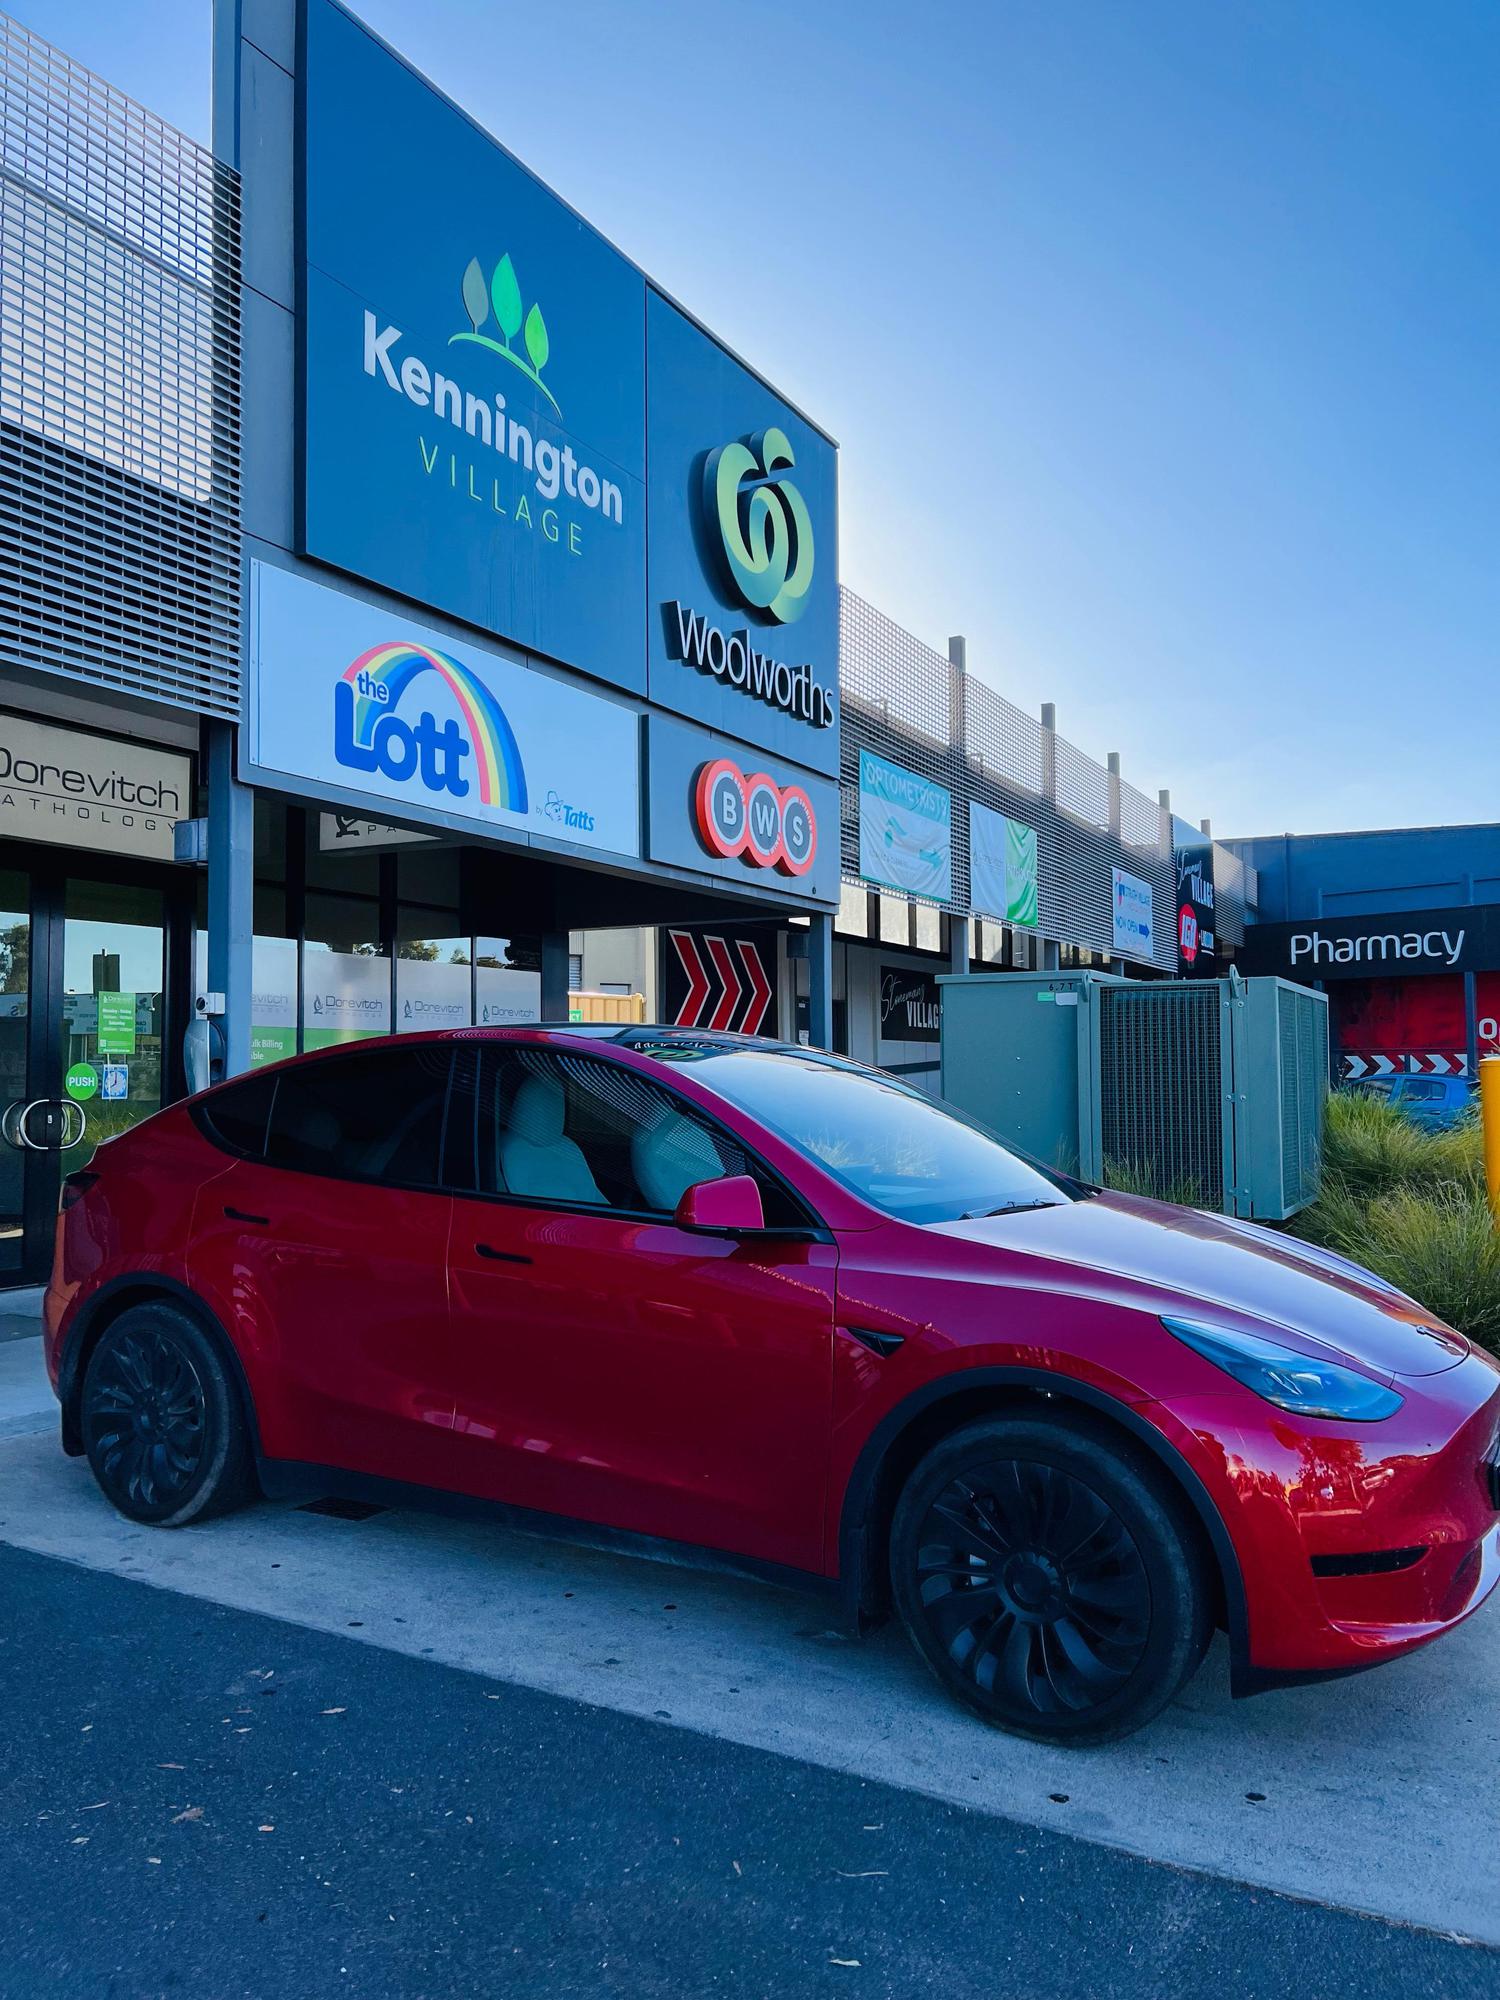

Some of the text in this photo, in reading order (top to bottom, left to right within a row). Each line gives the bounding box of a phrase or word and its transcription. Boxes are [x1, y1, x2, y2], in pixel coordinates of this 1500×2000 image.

[363, 308, 623, 525] Kennington
[419, 435, 583, 556] VILLAGE
[661, 599, 836, 730] Woolworths
[356, 672, 389, 702] the
[334, 681, 470, 798] Lott
[563, 804, 596, 832] Tatts
[722, 791, 804, 847] BWS
[1290, 929, 1466, 966] Pharmacy
[325, 995, 383, 1009] Dorevitch
[414, 1000, 465, 1014] Dorevitch
[491, 1005, 535, 1018] Dorevitch
[906, 1000, 940, 1029] VILLAG
[261, 1039, 284, 1051] Billing
[68, 1076, 95, 1087] PUSH
